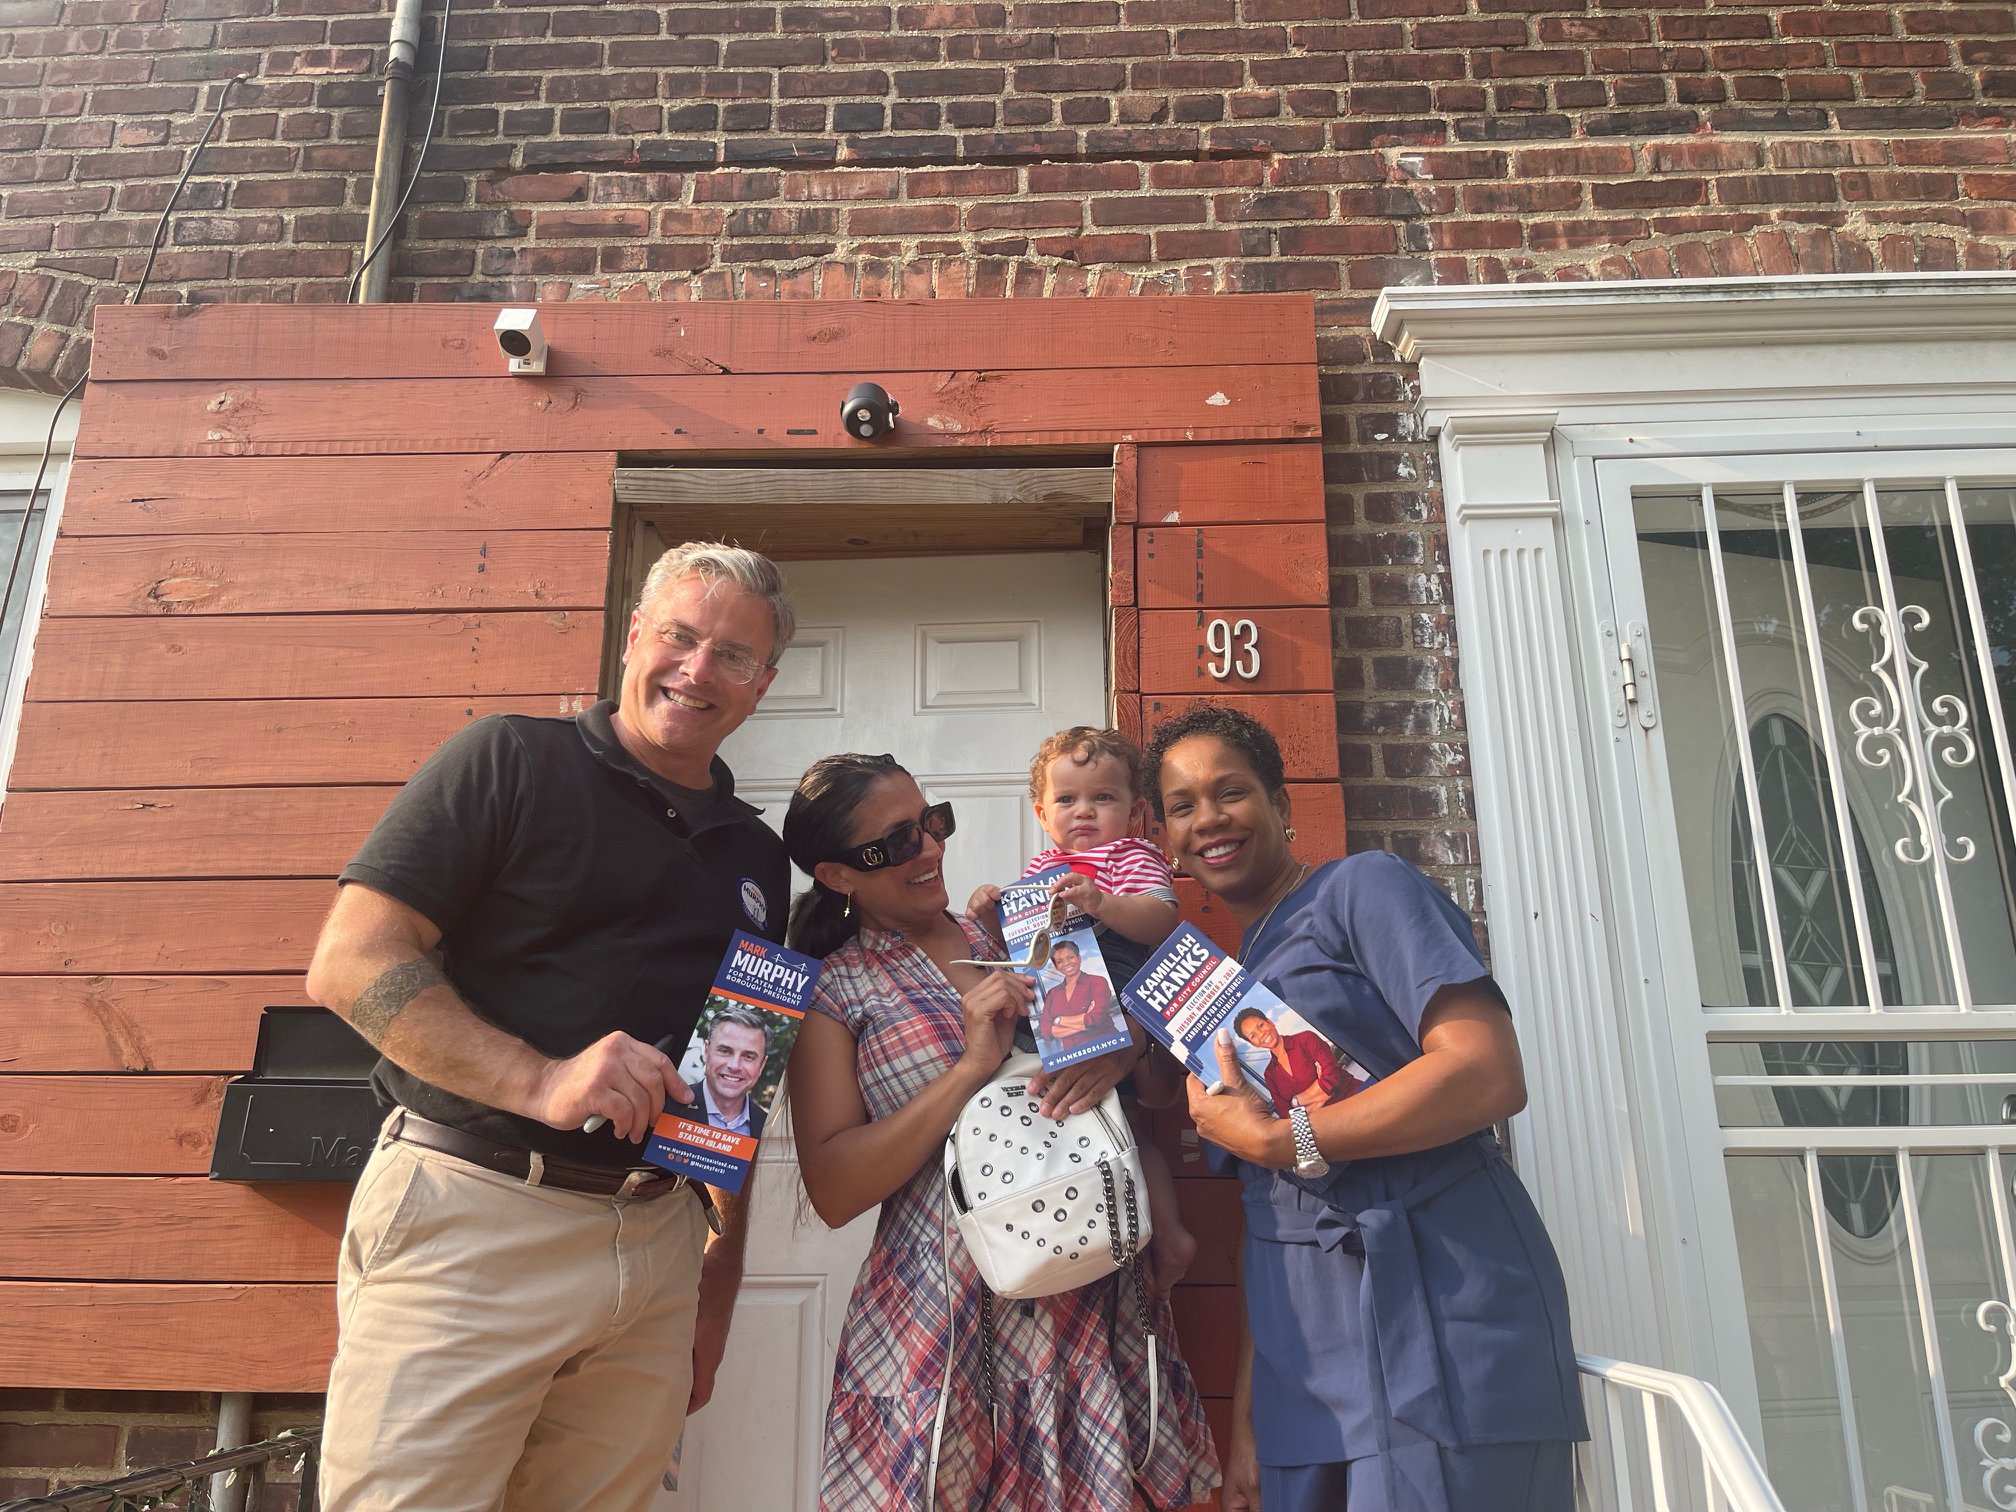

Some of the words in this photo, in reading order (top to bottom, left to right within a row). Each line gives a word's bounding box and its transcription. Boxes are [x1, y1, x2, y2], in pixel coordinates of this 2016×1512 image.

[1207, 618, 1261, 679] 93
[1024, 907, 1039, 916] CITY
[738, 939, 768, 959] MARK
[730, 949, 810, 993] MURPHY
[1136, 933, 1197, 1000] KAMILLAH
[1146, 942, 1210, 1013] HANKS
[726, 974, 761, 991] BOROUGH
[763, 988, 801, 1006] PRESIDENT
[728, 968, 743, 978] FOR
[745, 974, 773, 990] STATEN
[775, 985, 802, 1000] ISLAND
[1165, 1002, 1179, 1017] FOR
[1178, 987, 1192, 1003] CITY
[1191, 959, 1217, 987] COUNCIL
[1186, 988, 1207, 1012] ELECTION
[1204, 979, 1215, 992] DAY
[1176, 1011, 1199, 1035] TUESDAY,
[1198, 984, 1221, 1012] NOVEMBER
[1223, 967, 1236, 982] 2021
[1185, 1016, 1210, 1043] CANDIDATE
[1207, 1006, 1218, 1017] FOR
[1216, 993, 1228, 1007] CITY
[1225, 975, 1245, 996] COUNCIL
[1216, 997, 1238, 1019] DISTRICT
[1056, 1039, 1118, 1064] HANKS2021.NYC
[678, 1121, 692, 1131] IT'S
[693, 1127, 710, 1137] TIME
[711, 1131, 721, 1139] TO
[721, 1134, 742, 1145] SAVE
[678, 1131, 705, 1145] STATEN
[705, 1139, 733, 1152] ISLAND
